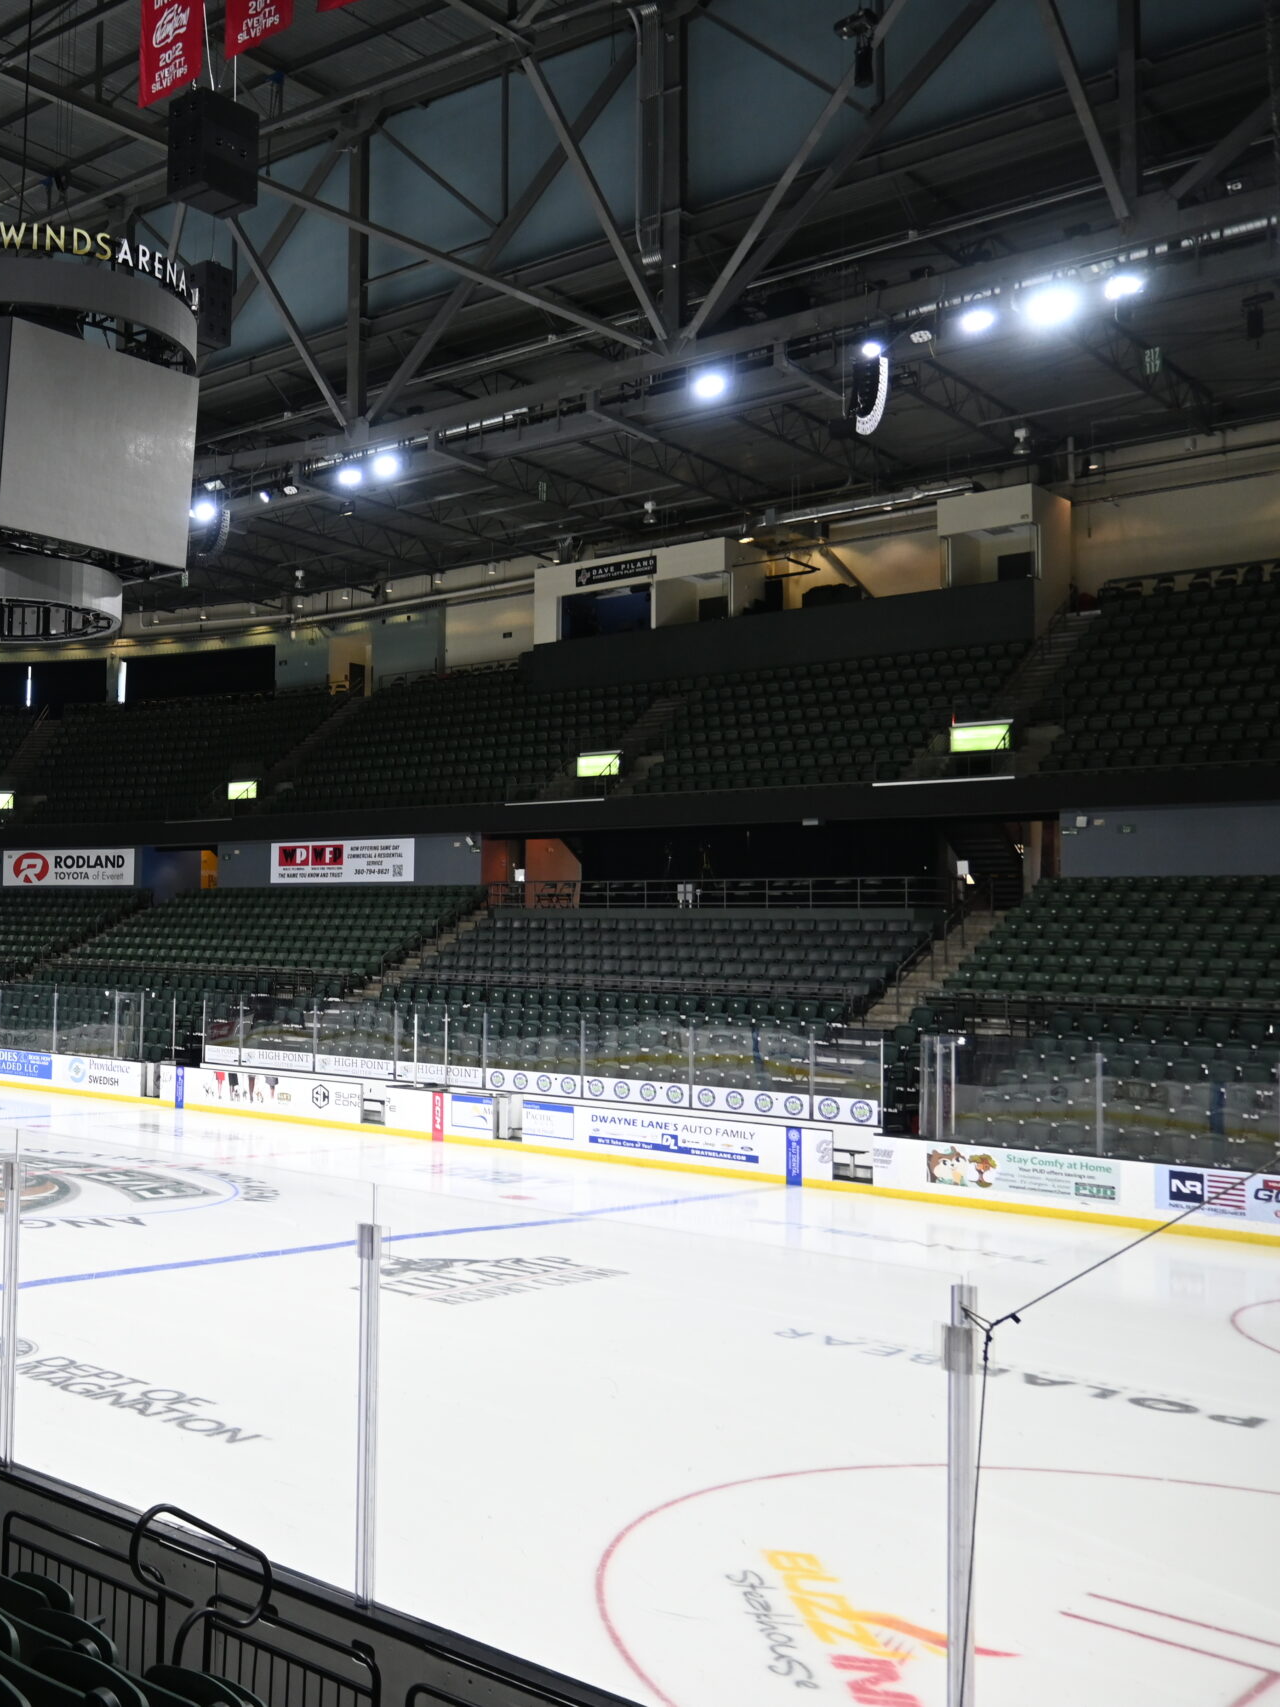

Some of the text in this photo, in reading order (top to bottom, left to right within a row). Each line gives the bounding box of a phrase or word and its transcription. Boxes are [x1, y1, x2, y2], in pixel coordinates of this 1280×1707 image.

[243, 6, 276, 31] EVERETT
[238, 15, 280, 43] SILVERTIPS
[159, 42, 183, 67] 2022
[155, 57, 186, 81] EVERETT
[151, 65, 188, 93] SILVERTIPS
[0, 221, 113, 260] WINDS
[116, 238, 188, 297] ARENA
[592, 560, 654, 576] DAVE PILAND
[54, 855, 125, 869] RODLAND
[54, 871, 124, 881] TOYOTA of Everett
[258, 1050, 310, 1063] HIGH POINT
[333, 1056, 391, 1070] HIGH POINT
[25, 1065, 38, 1073] LLC
[89, 1059, 131, 1074] Providence
[417, 1064, 478, 1078] HIGH POINT
[88, 1075, 119, 1087] SWEDISH
[434, 1095, 442, 1129] CCM
[591, 1114, 756, 1140] DWAYNE LANE'S AUTO FAMILY
[691, 1149, 746, 1161] DWAYNELANE.COM
[1006, 1154, 1112, 1173] Stay Comfy at Home
[1171, 1179, 1202, 1195] NR
[36, 1356, 218, 1408] DEPT OF
[725, 1568, 820, 1692] Steakhouse
